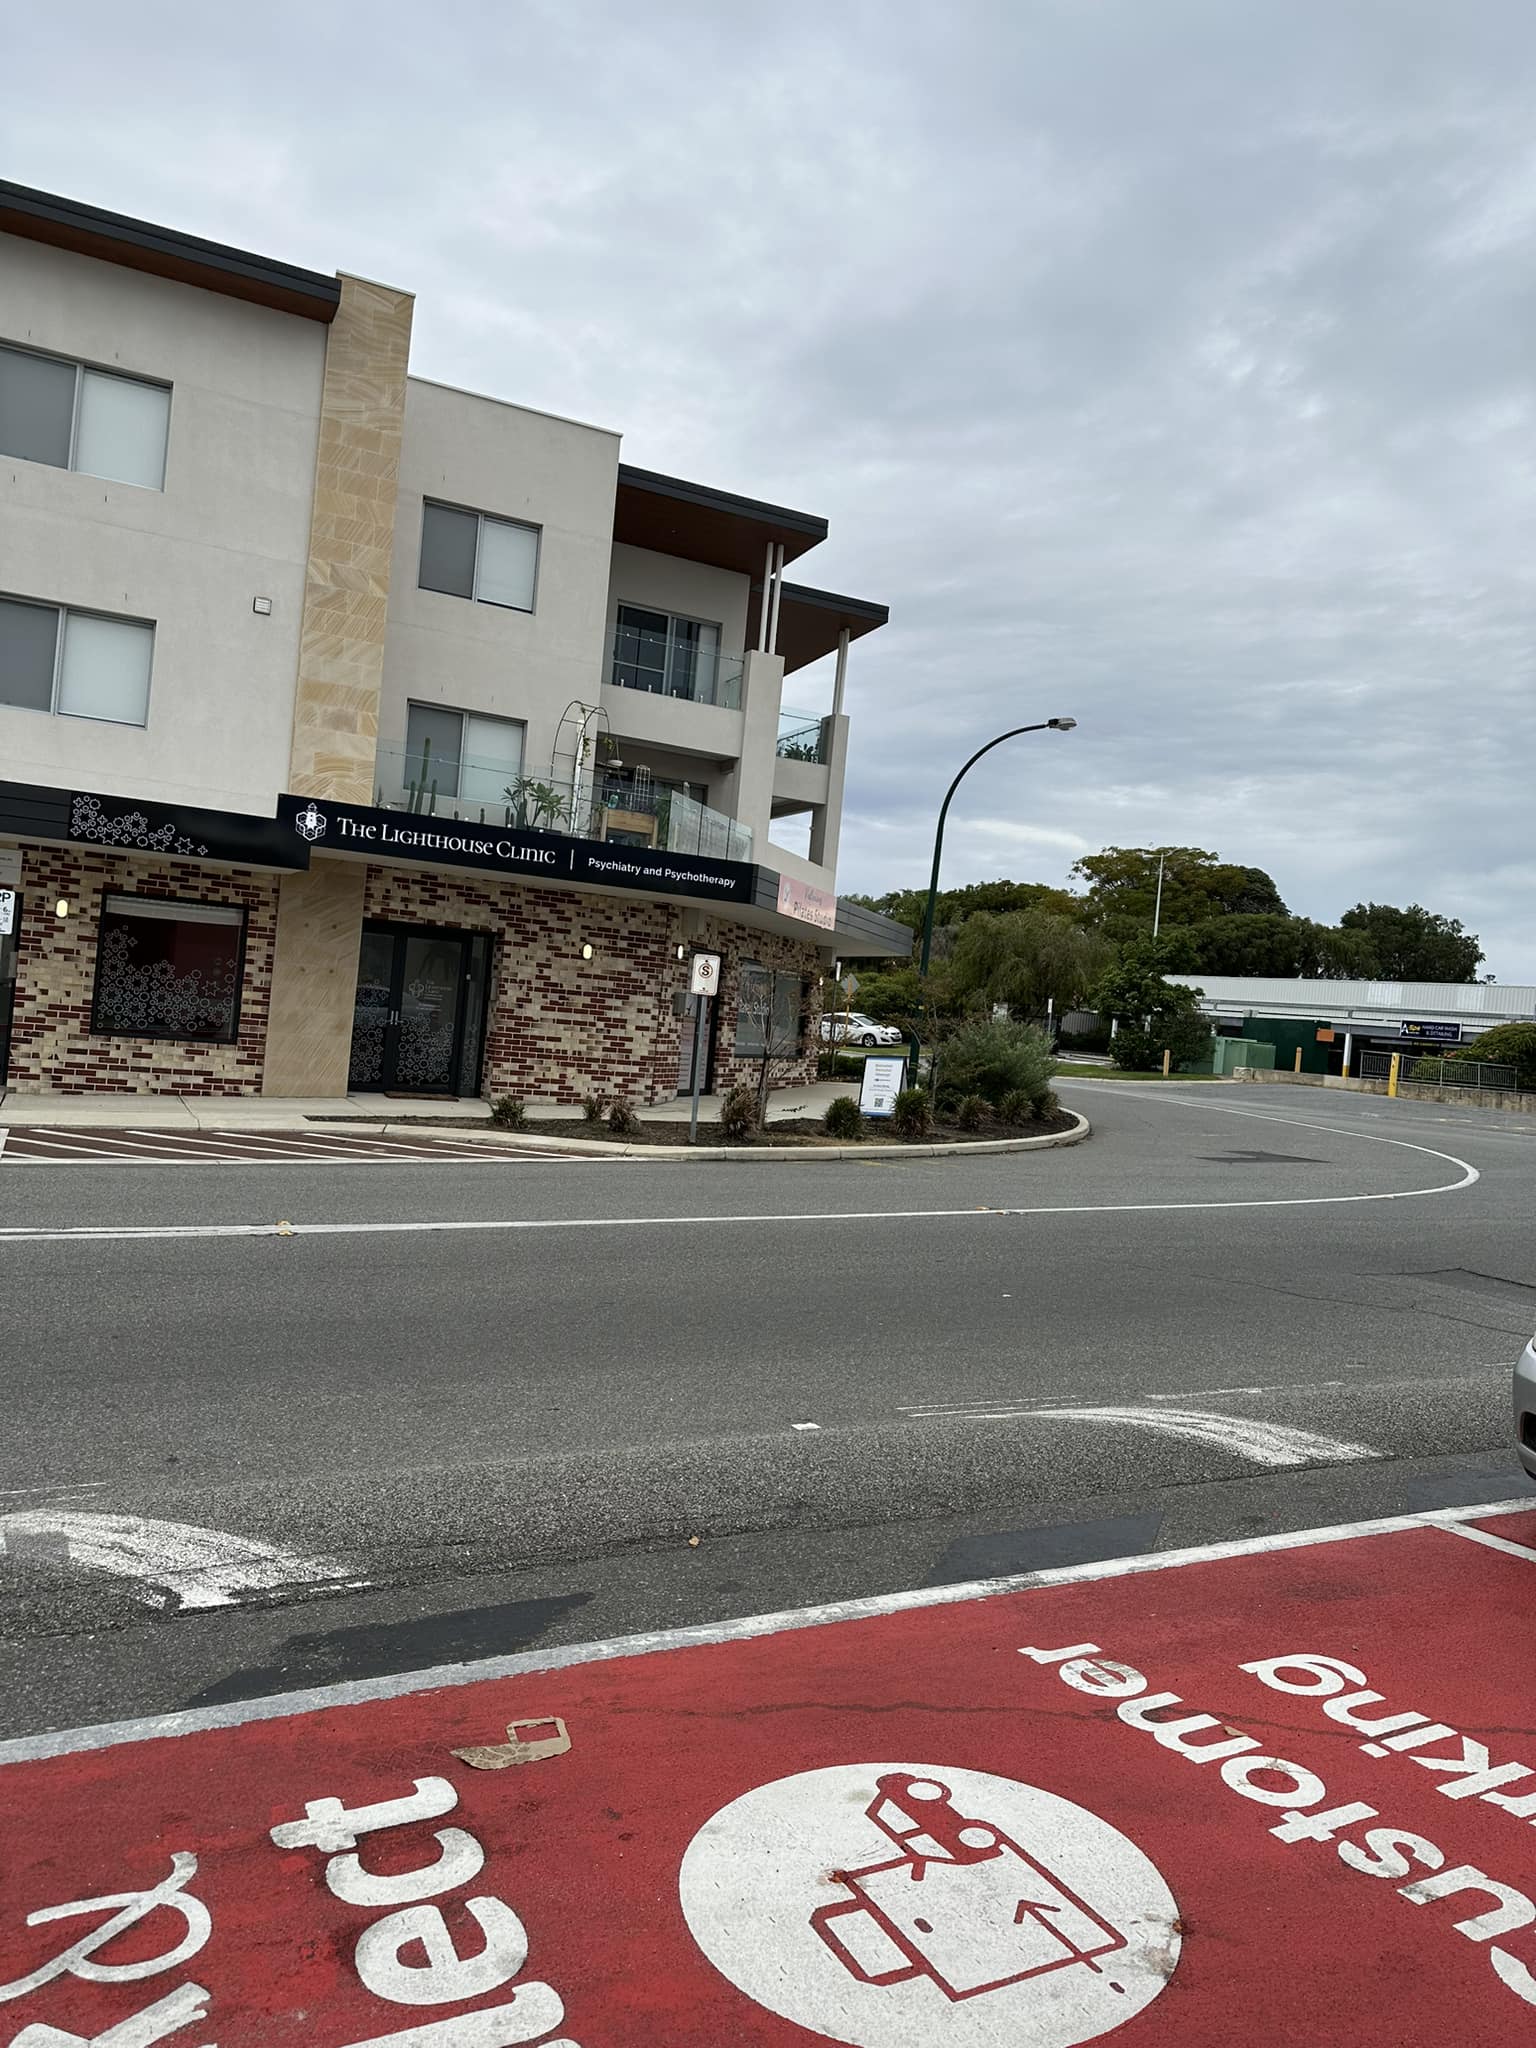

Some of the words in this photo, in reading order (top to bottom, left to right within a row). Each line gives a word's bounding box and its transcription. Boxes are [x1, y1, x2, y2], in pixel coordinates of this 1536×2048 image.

[588, 857, 642, 876] Psychiatry
[643, 867, 663, 877] and
[664, 868, 736, 889] Psychotherapy
[793, 900, 813, 921] Pilates
[1238, 1653, 1536, 1823] rking
